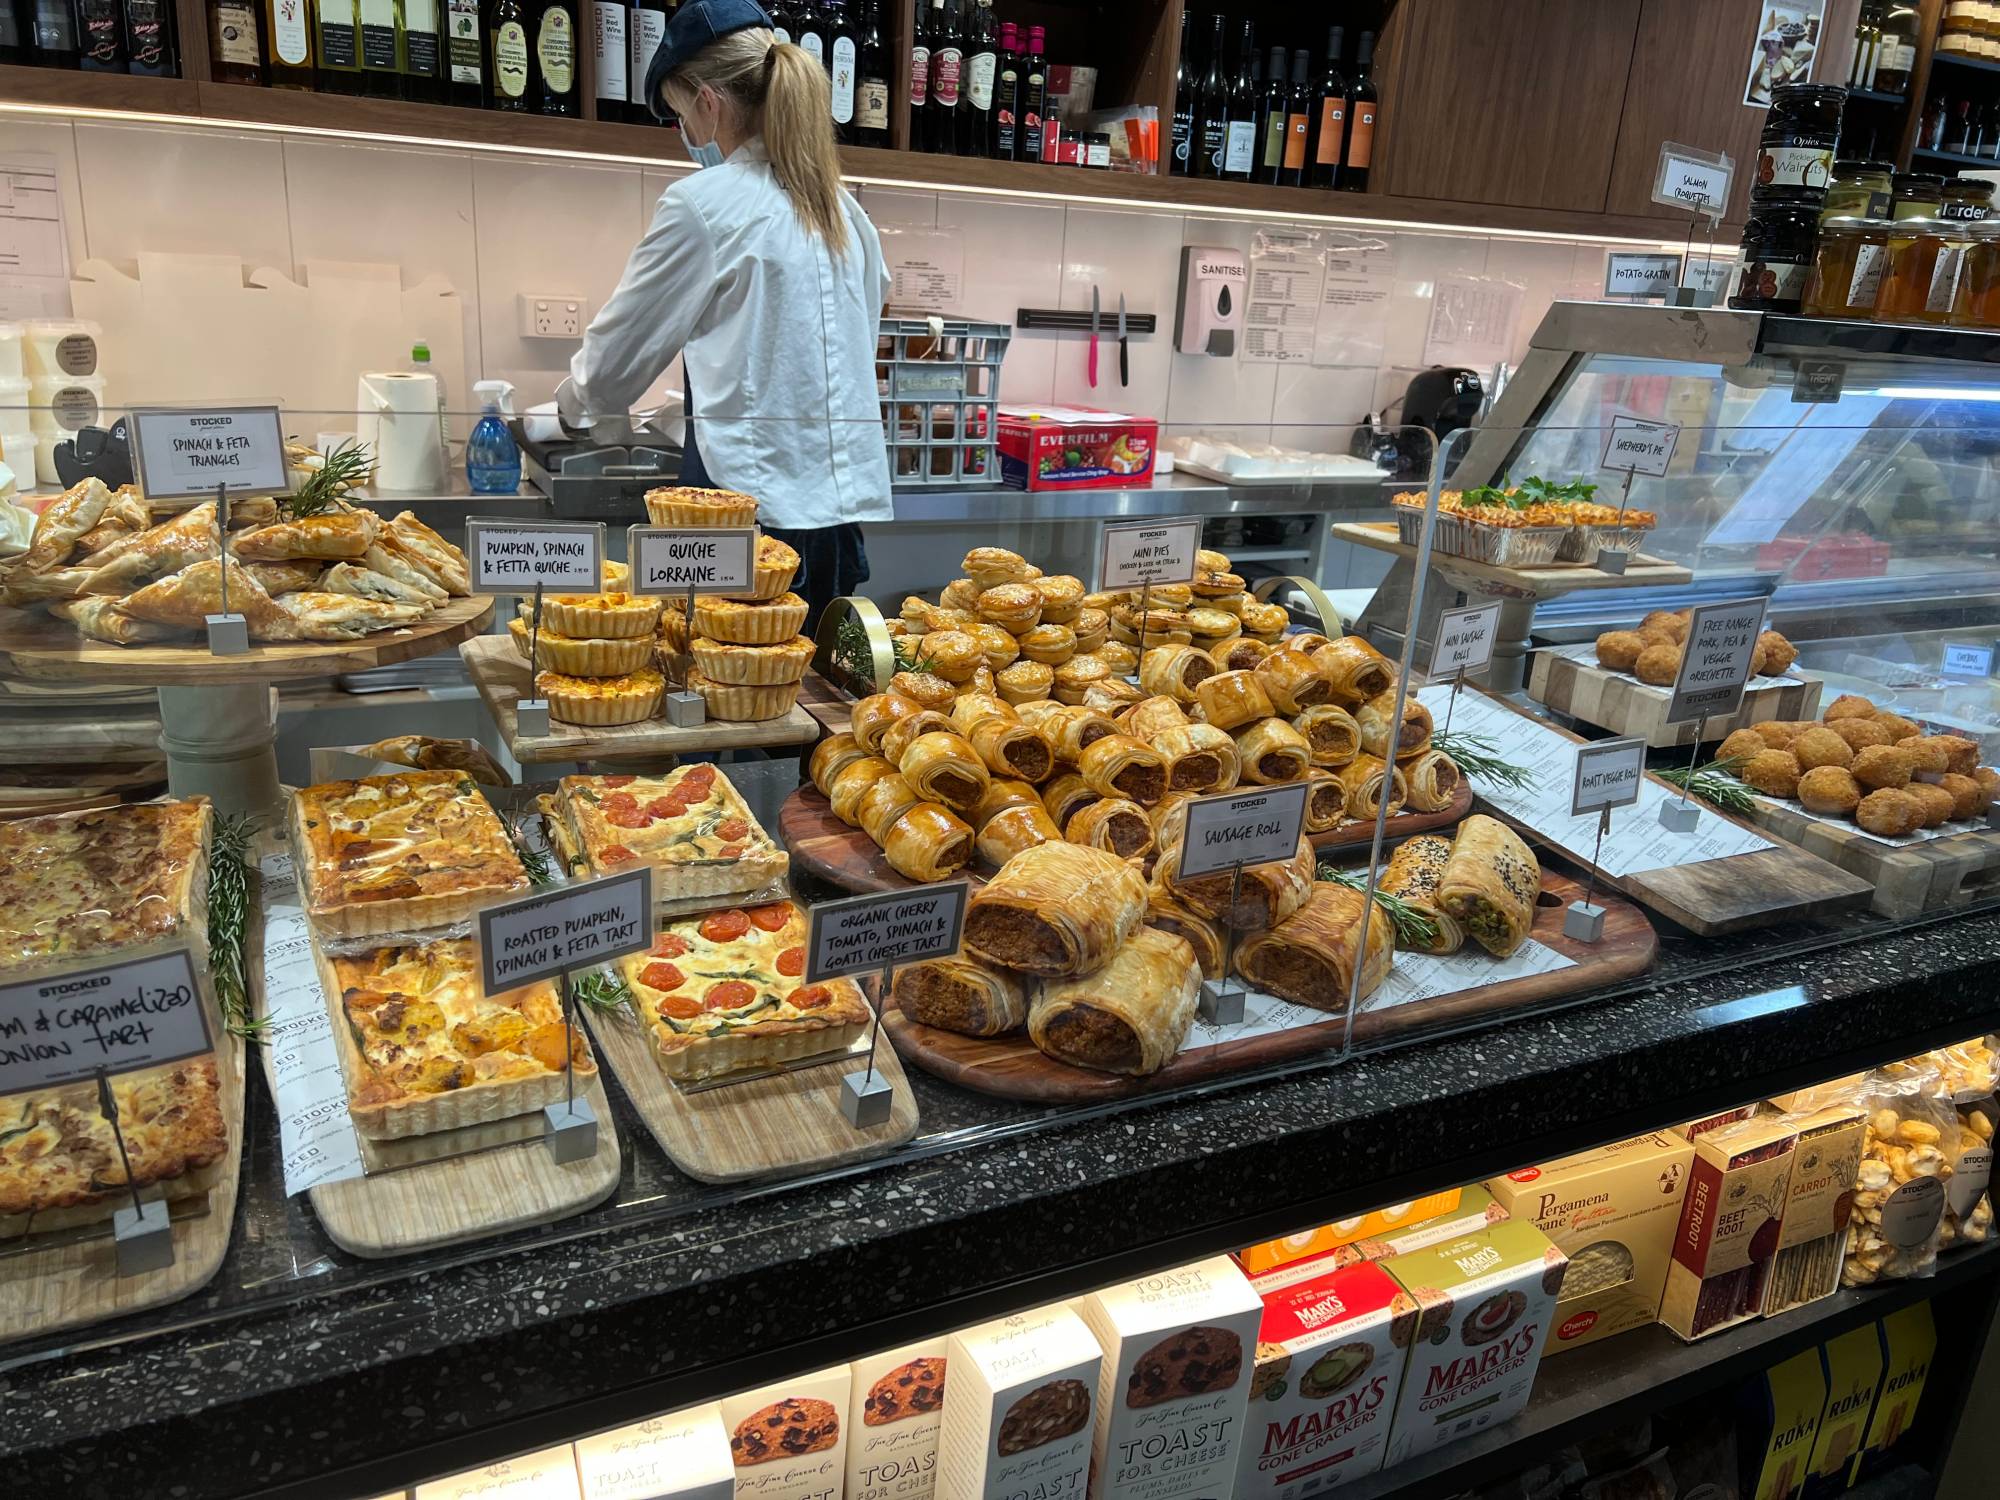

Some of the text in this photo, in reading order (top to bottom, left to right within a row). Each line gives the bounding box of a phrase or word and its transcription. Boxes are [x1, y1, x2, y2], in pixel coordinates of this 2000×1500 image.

[595, 8, 604, 58] STOCKED
[605, 19, 618, 27] Red
[605, 26, 621, 34] Wine
[633, 14, 641, 64] STOCKED
[1793, 136, 1820, 146] Opies
[1788, 152, 1817, 161] Pickled
[1775, 161, 1824, 176] Walnuts
[1683, 174, 1709, 190] SALMON
[1674, 187, 1711, 205] CROQUETTES
[1942, 202, 1986, 219] larder
[1615, 268, 1671, 280] POTATO GRATIN
[190, 416, 233, 427] STOCKED
[173, 436, 250, 451] SPINACH & FETA
[1040, 432, 1109, 447] EVERFILM
[187, 453, 241, 467] TRIANGLES
[486, 527, 518, 535] STOCKED
[1139, 530, 1168, 539] STOCKED
[487, 541, 585, 557] PUMPKIN, SPINACH
[669, 541, 717, 561] QUICHE
[1132, 544, 1170, 560] MINI PIES
[483, 560, 493, 574] &
[496, 559, 531, 575] FETTA
[534, 560, 571, 575] QUICHE
[650, 565, 717, 584] LORRAINE
[1702, 617, 1754, 635] FREE RANGE
[1697, 637, 1720, 650] PORK,
[1722, 635, 1739, 648] PEA
[1702, 651, 1734, 667] VEGGIE
[1686, 688, 1732, 705] STOCKED
[1581, 767, 1638, 790] ROAST VEGGIE ROLL
[1230, 797, 1268, 810] STOCKED
[1204, 820, 1283, 847] SAUSAGE ROLL
[499, 901, 544, 919] STOCKED
[840, 905, 891, 929] ORGANIC
[895, 899, 938, 922] CHERRY
[504, 905, 625, 951] ROASTED PUMPKIN,
[826, 917, 948, 952] TOMATO, SPINACH &
[496, 920, 639, 977] SPINACH & FETA TART
[825, 933, 947, 970] GOATS CHEESE TART
[38, 975, 112, 998] STOCKED
[35, 1009, 50, 1032] &
[292, 1098, 351, 1126] STOCKE
[1792, 1174, 1834, 1196] CARROT
[1901, 1179, 1937, 1195] STOCKED
[1536, 1193, 1610, 1222] Pergamena
[1687, 1180, 1710, 1251] BEETROOT
[1718, 1208, 1748, 1227] BEET
[1716, 1221, 1746, 1239] ROOT
[1454, 1246, 1500, 1273] MARY'S
[1128, 1269, 1205, 1295] TOAST
[1139, 1281, 1214, 1304] FOR CHEESE
[1293, 1295, 1344, 1325] MARY'S
[1562, 1317, 1594, 1333] Cherchi
[1424, 1323, 1539, 1398] MARY'S
[1418, 1355, 1527, 1413] GONE CRACKERS
[1886, 1363, 1927, 1395] ROKA
[1829, 1387, 1873, 1420] ROKA
[1262, 1375, 1389, 1456] MARY'S
[1119, 1416, 1233, 1465] TOAST
[1258, 1447, 1307, 1472] GONE
[1305, 1409, 1378, 1455] CRACKERS
[1773, 1416, 1816, 1452] ROKA
[859, 1450, 936, 1487] TOAS
[1115, 1443, 1229, 1483] FOR CHEESE
[593, 1461, 659, 1488] TOAST
[1168, 1471, 1199, 1487] DATES
[856, 1470, 937, 1500] FOR CHEE
[1143, 1481, 1194, 1500] LINSEEDS
